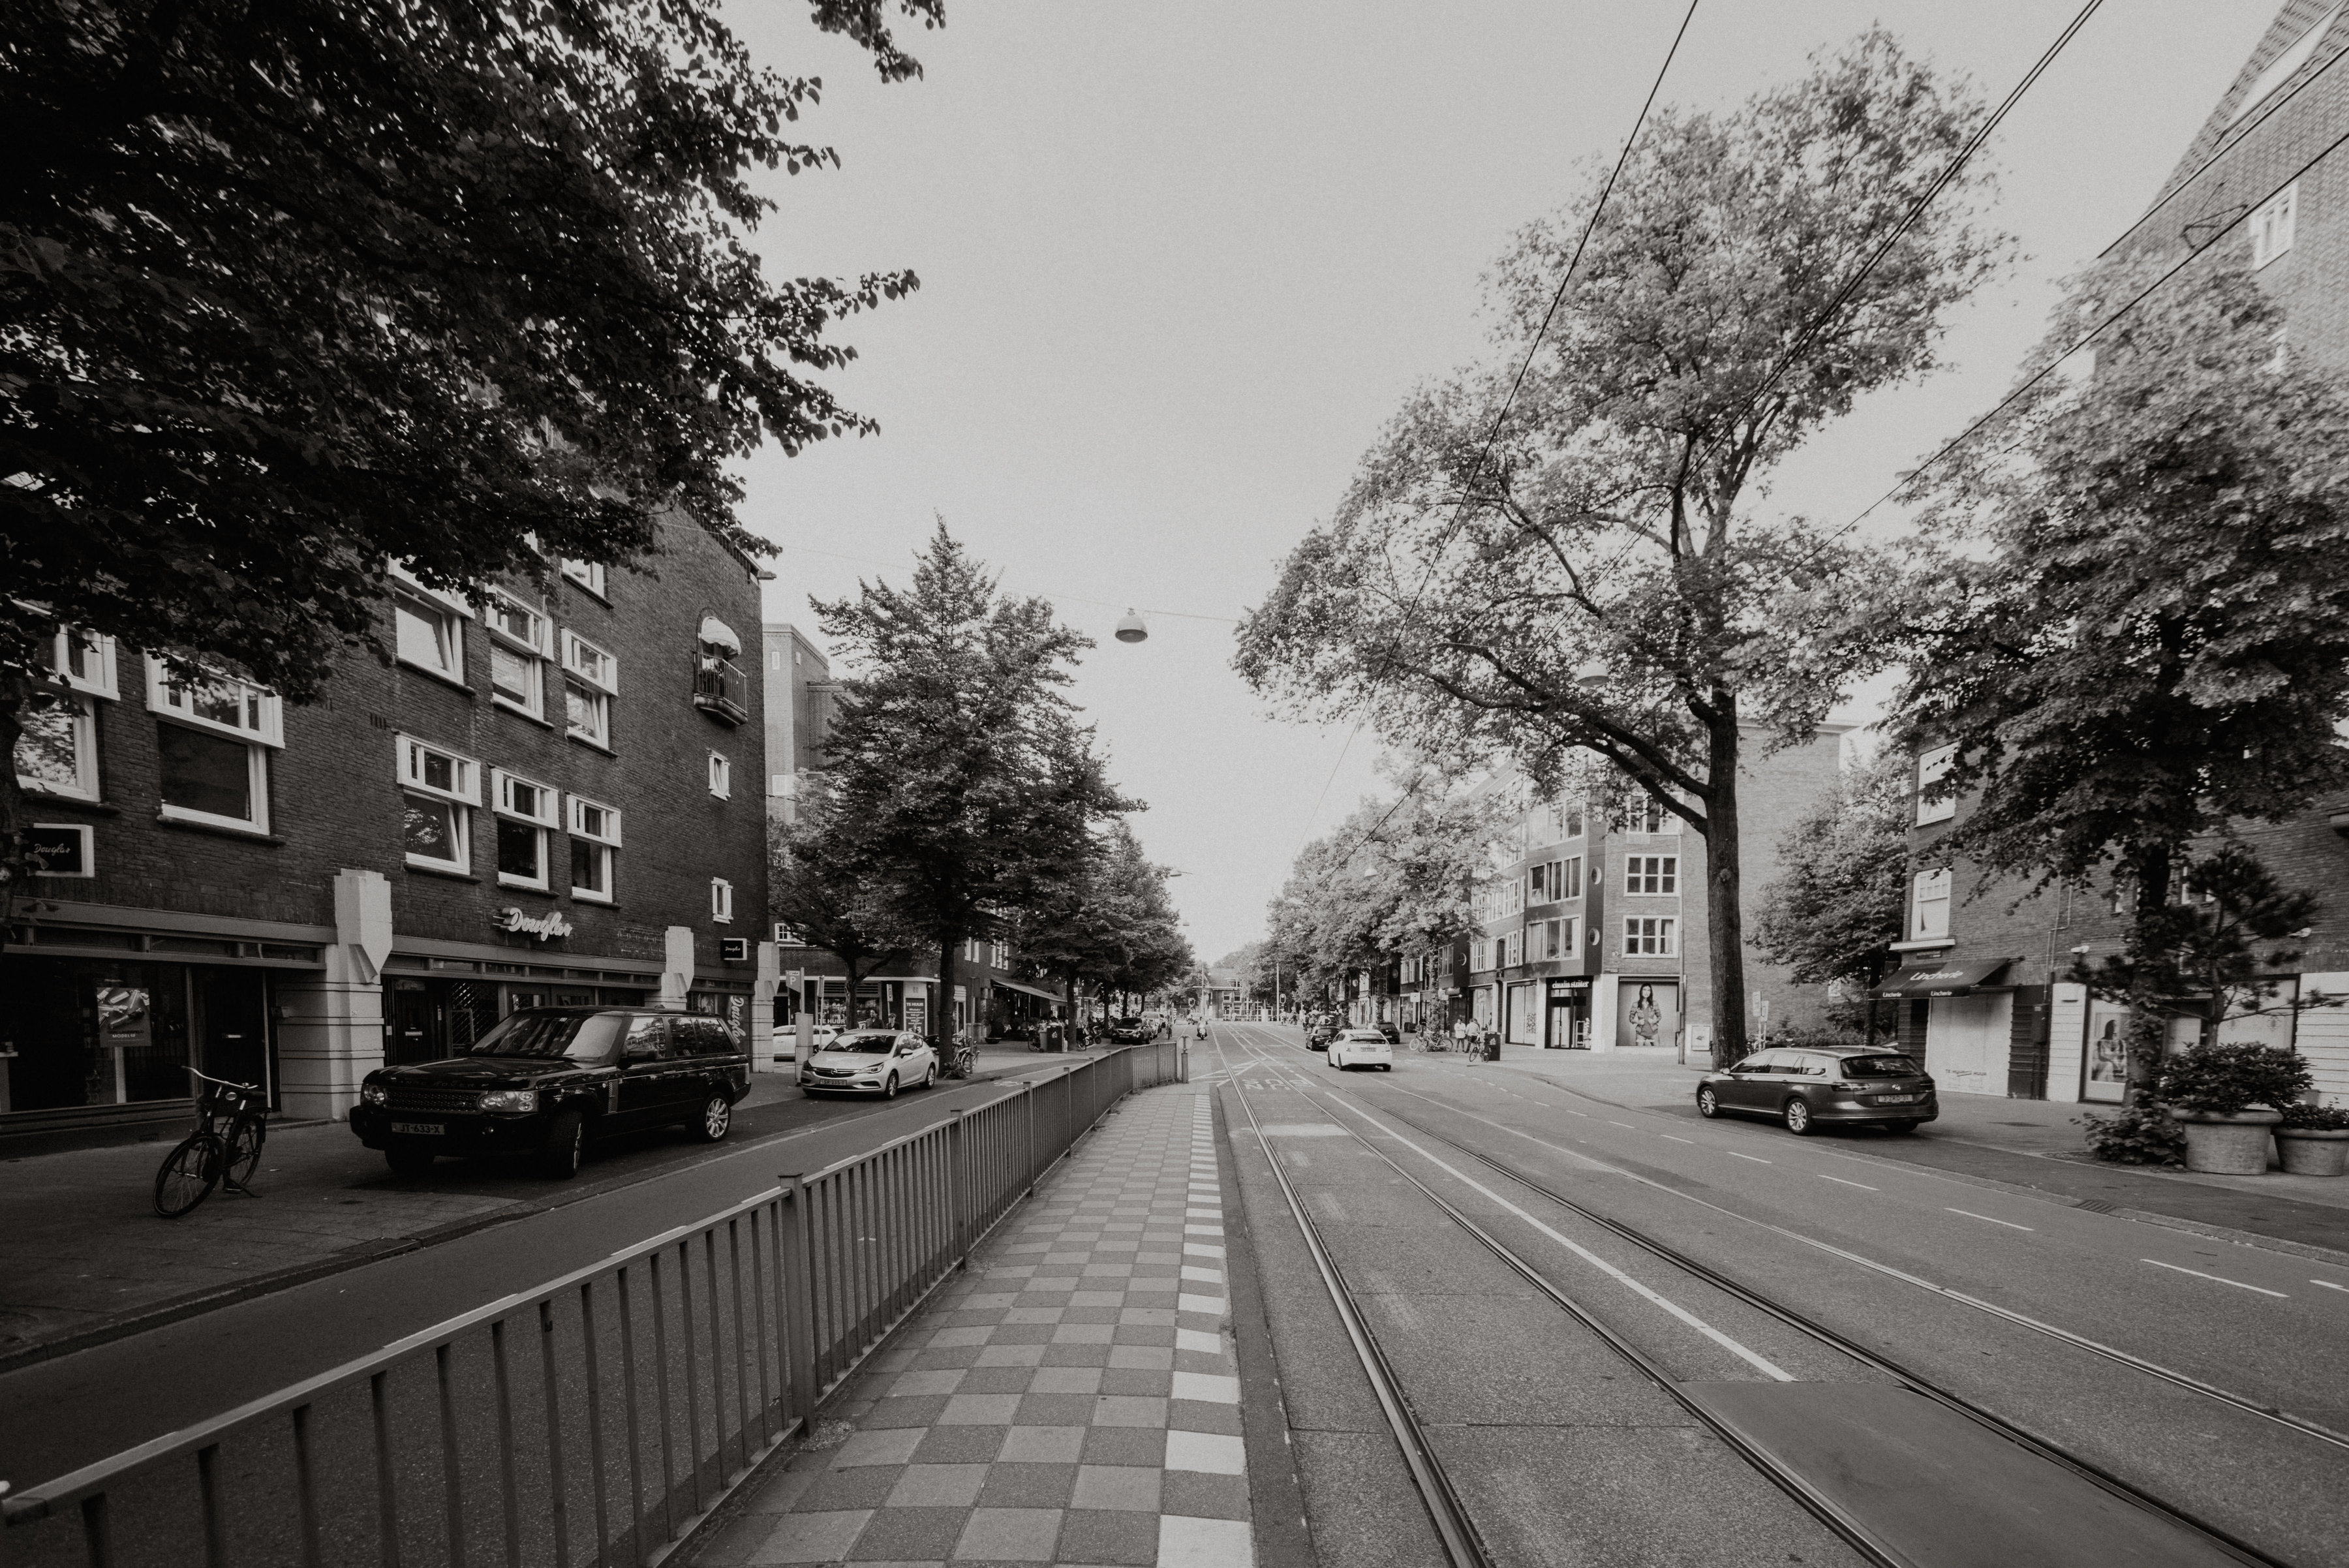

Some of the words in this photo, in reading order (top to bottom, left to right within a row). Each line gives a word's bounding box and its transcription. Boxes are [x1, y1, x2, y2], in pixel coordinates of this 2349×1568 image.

[33, 842, 70, 856] Douglas
[504, 906, 574, 942] Douglas
[1910, 970, 1963, 980] Lincherie
[790, 976, 796, 985] P
[1552, 980, 1570, 989] claudia
[401, 1124, 440, 1133] JT-633-X
